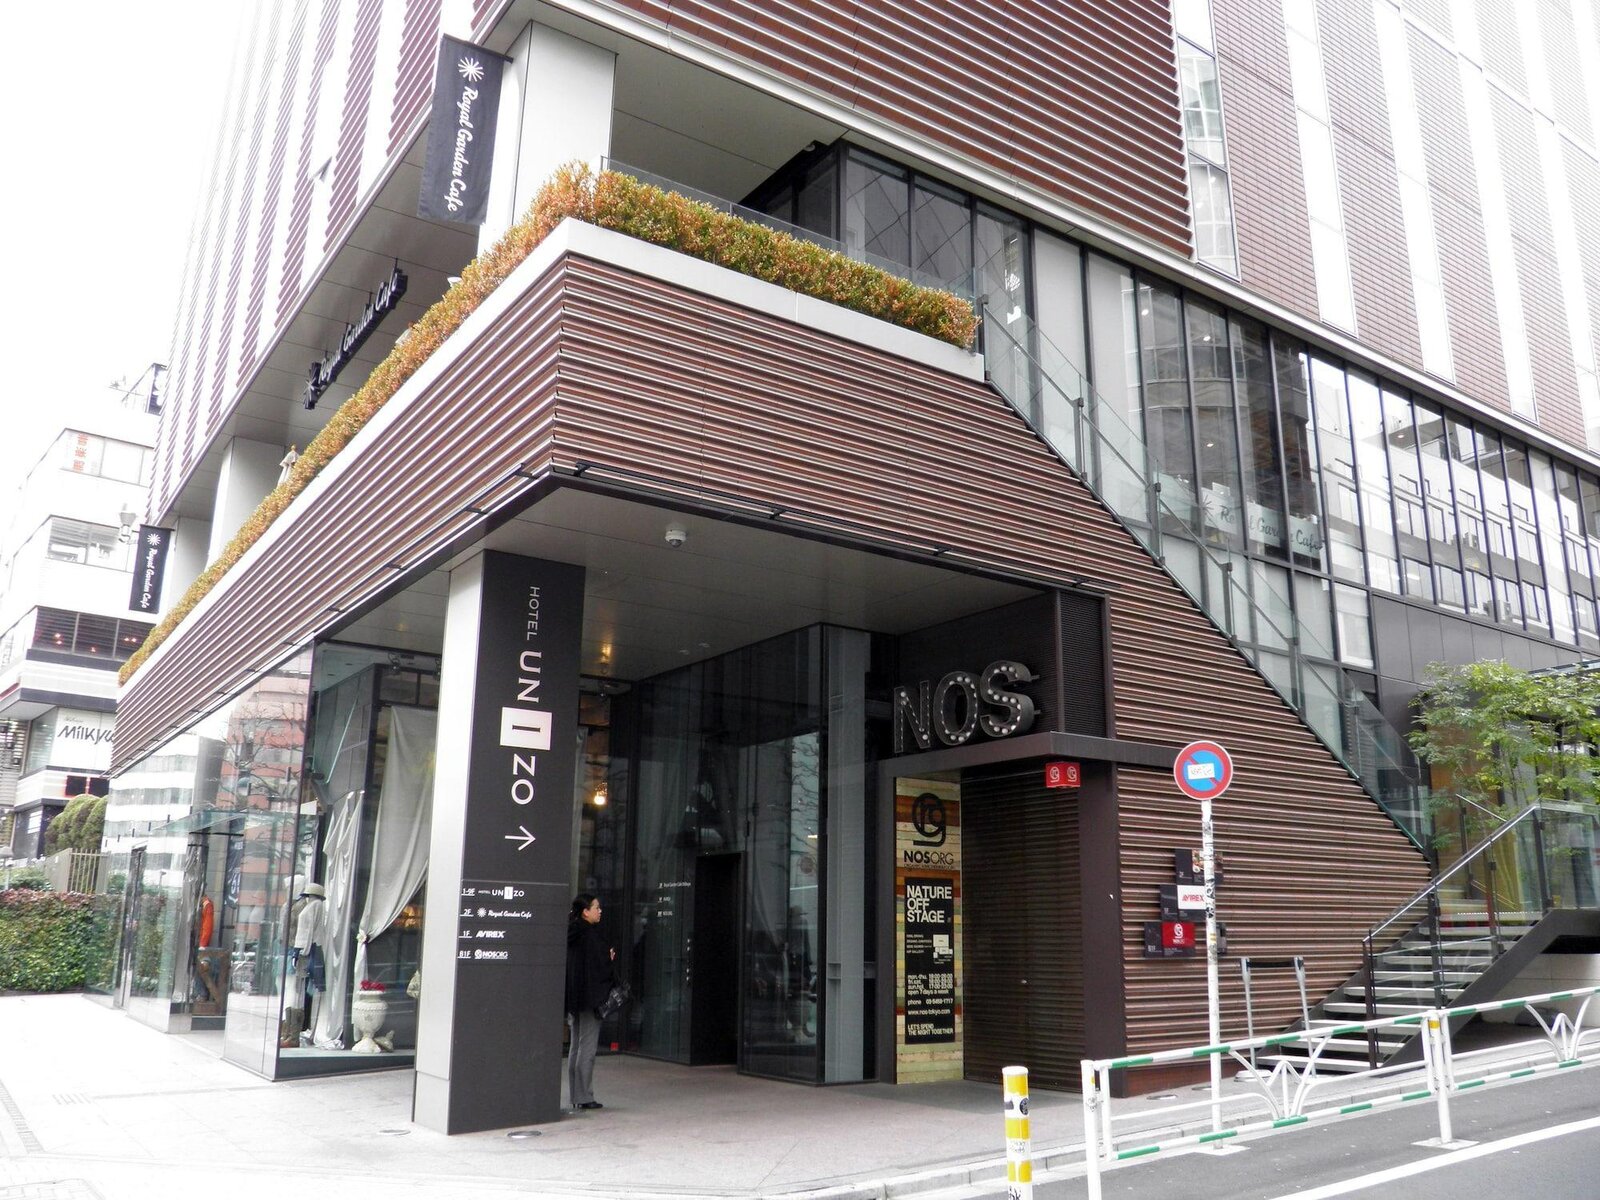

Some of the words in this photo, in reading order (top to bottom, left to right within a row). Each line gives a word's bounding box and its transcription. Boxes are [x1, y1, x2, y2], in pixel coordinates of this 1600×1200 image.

[457, 85, 478, 129] Royal
[451, 129, 473, 176] Garden
[444, 178, 467, 212] Cafe
[146, 547, 158, 569] Royal
[143, 569, 155, 592] Garden
[140, 592, 152, 608] Cafe
[527, 586, 541, 641] HOTEL
[893, 660, 1035, 753] NOS
[508, 650, 544, 805] UNIZO
[491, 887, 525, 899] UNIZO
[906, 885, 953, 900] NATURE
[1182, 894, 1205, 903] AVIREX
[906, 897, 930, 911] OFF
[488, 909, 503, 918] Royal
[520, 911, 532, 919] Cafe
[906, 910, 945, 923] STAGE
[475, 930, 506, 938] AVIREX
[931, 1027, 954, 1035] TOGETHER
